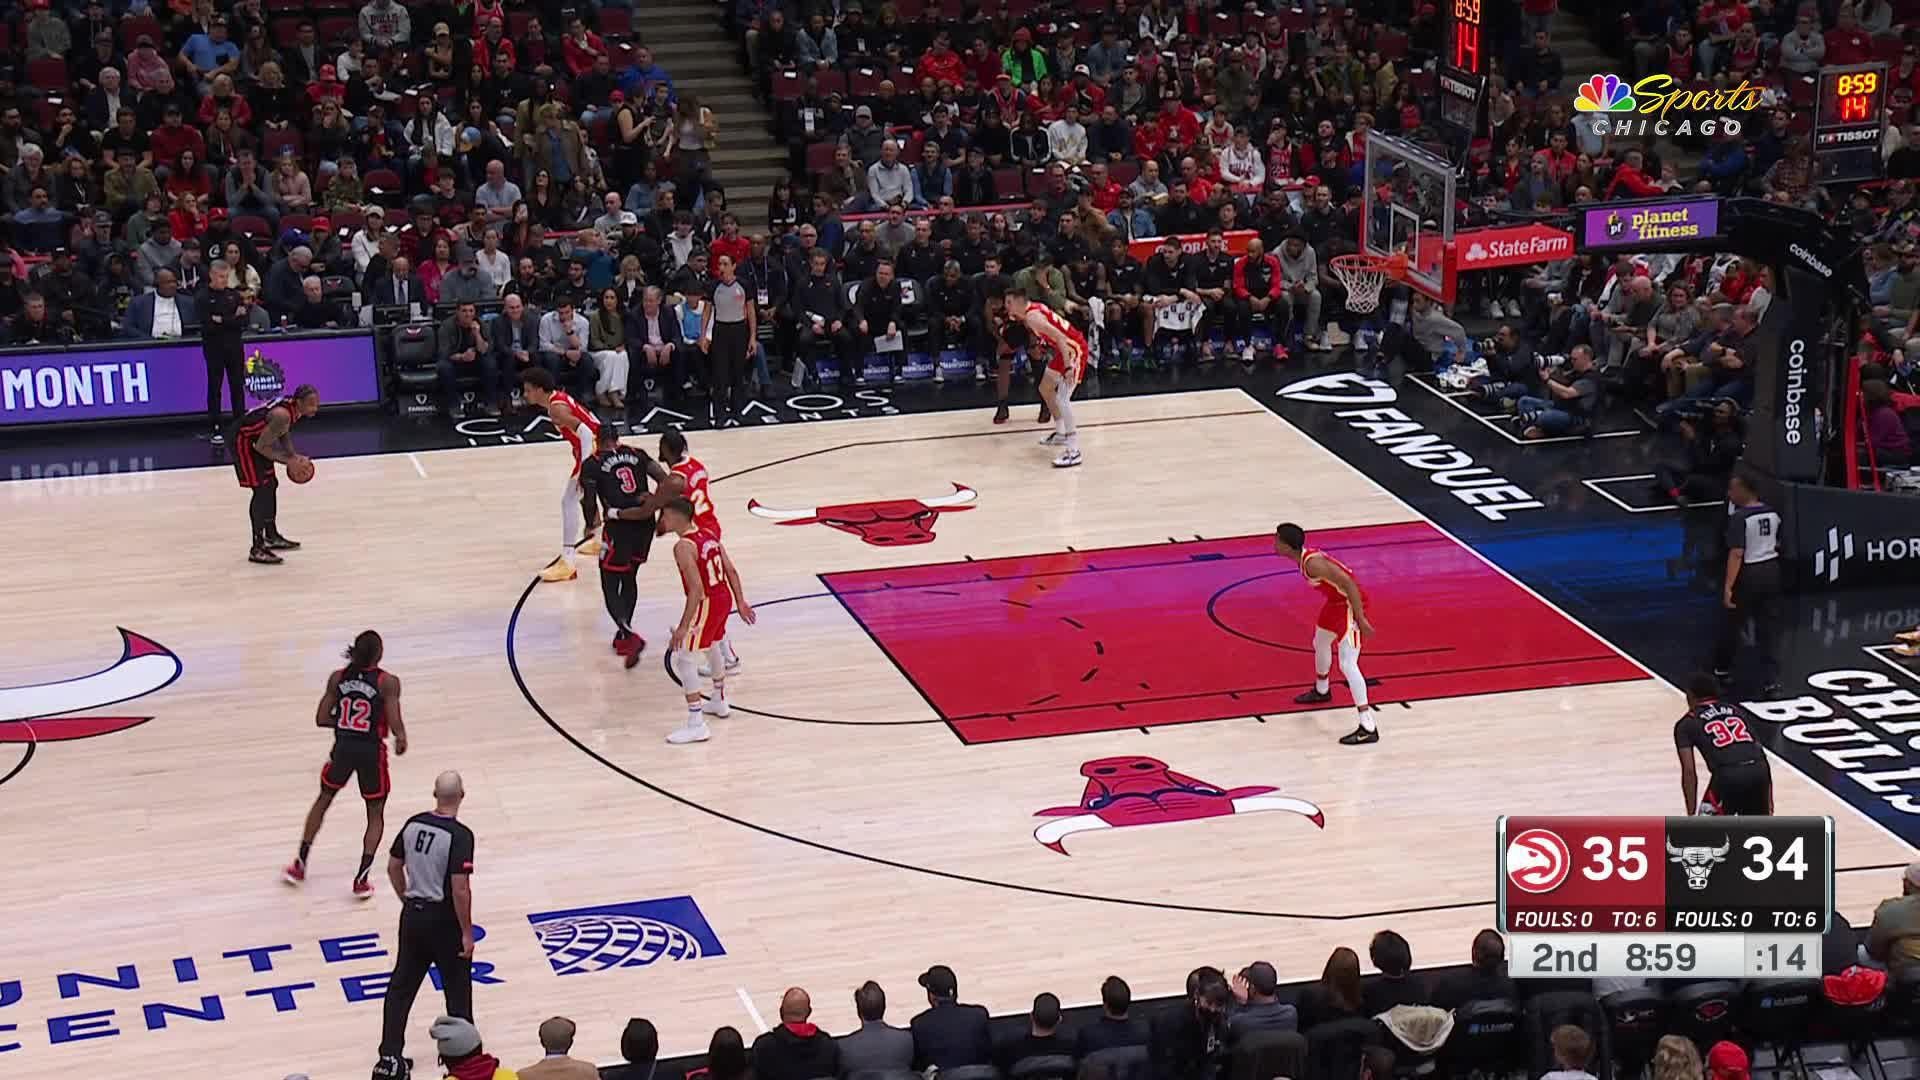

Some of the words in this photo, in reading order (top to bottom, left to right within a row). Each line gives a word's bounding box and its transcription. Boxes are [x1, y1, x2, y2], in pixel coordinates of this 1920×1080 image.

[1457, 22, 1479, 73] 14
[1838, 72, 1877, 96] 8:59
[1842, 96, 1867, 119] 14
[1632, 208, 1689, 231] planet
[1639, 221, 1700, 240] fitness
[1789, 243, 1833, 277] coinbase
[1, 362, 149, 410] MONTH
[1785, 339, 1808, 445] coinbase
[1334, 407, 1544, 521] FANDUEL
[616, 466, 637, 494] 3
[1758, 517, 1771, 536] 19
[337, 696, 372, 733] 12
[1704, 716, 1754, 747] 32
[415, 829, 436, 855] 67
